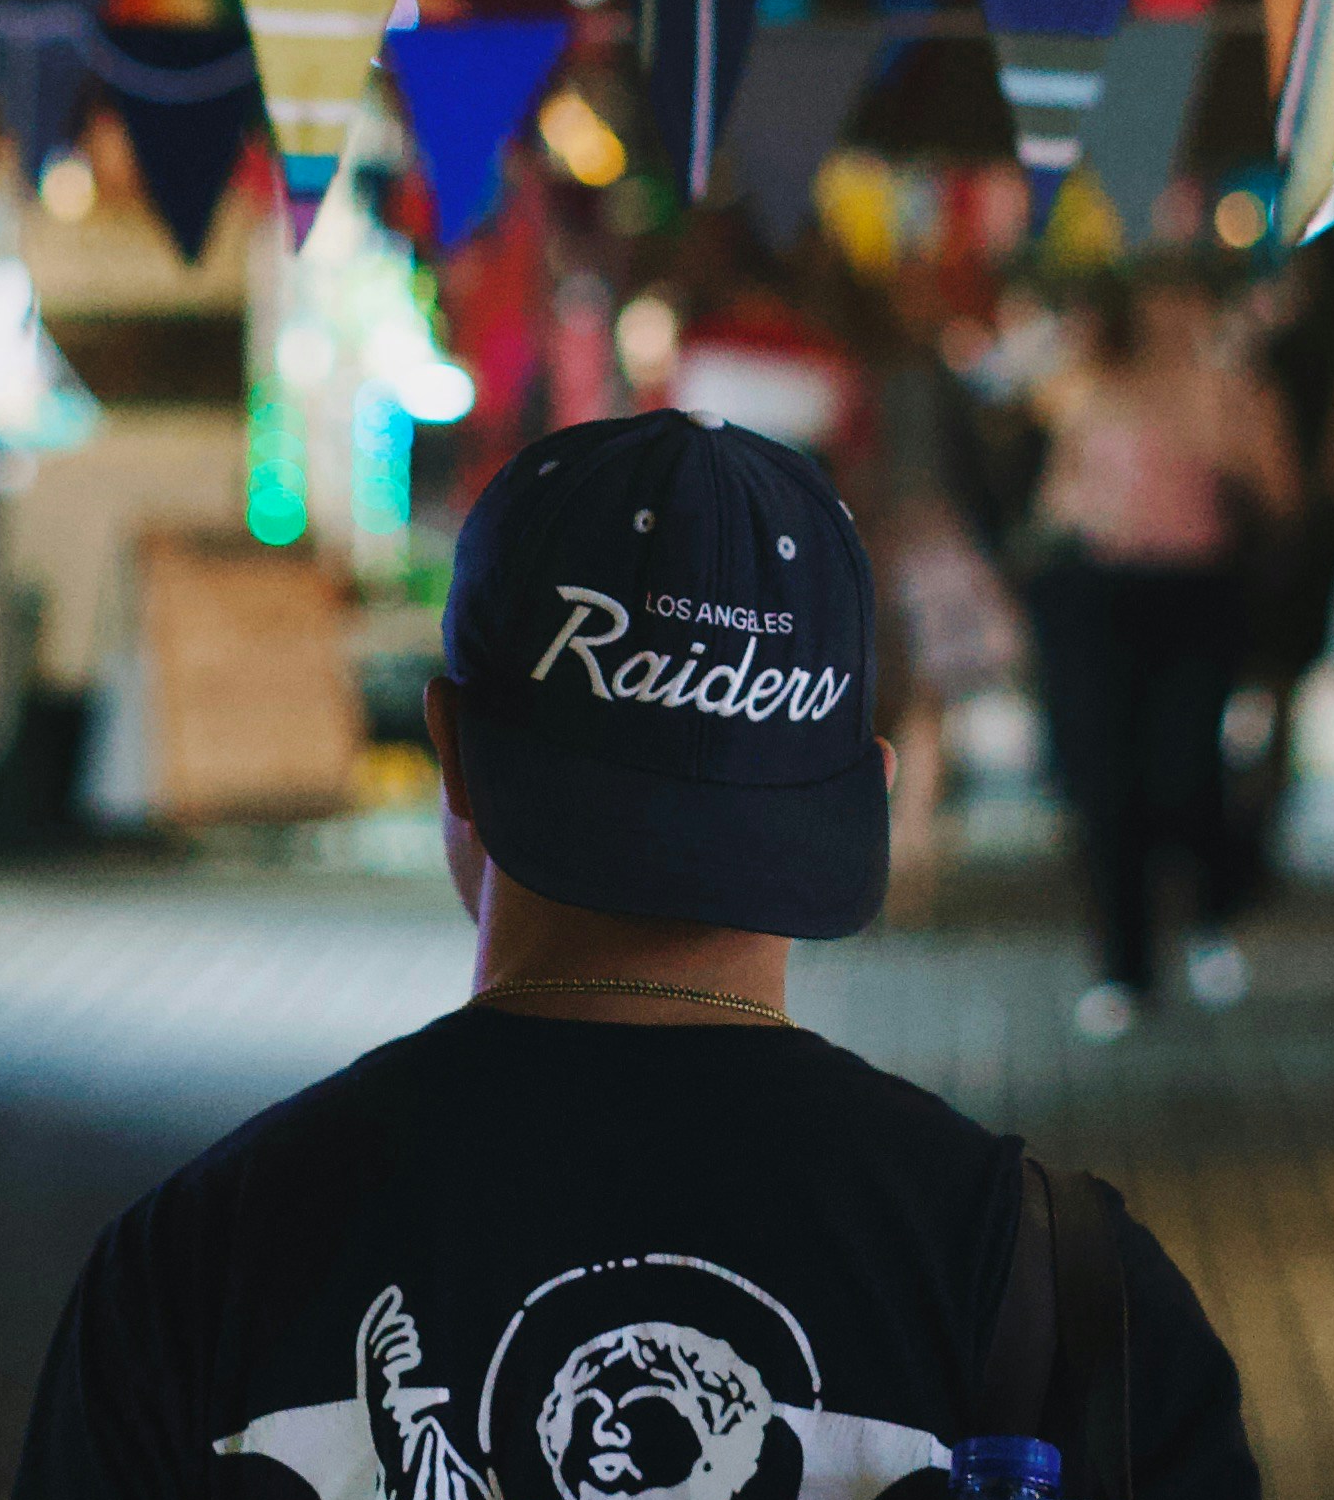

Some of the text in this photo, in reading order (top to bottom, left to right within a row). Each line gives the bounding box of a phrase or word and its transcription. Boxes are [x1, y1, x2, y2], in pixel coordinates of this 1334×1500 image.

[530, 584, 852, 724] Raiders
[645, 590, 794, 635] LOS ANGELES
